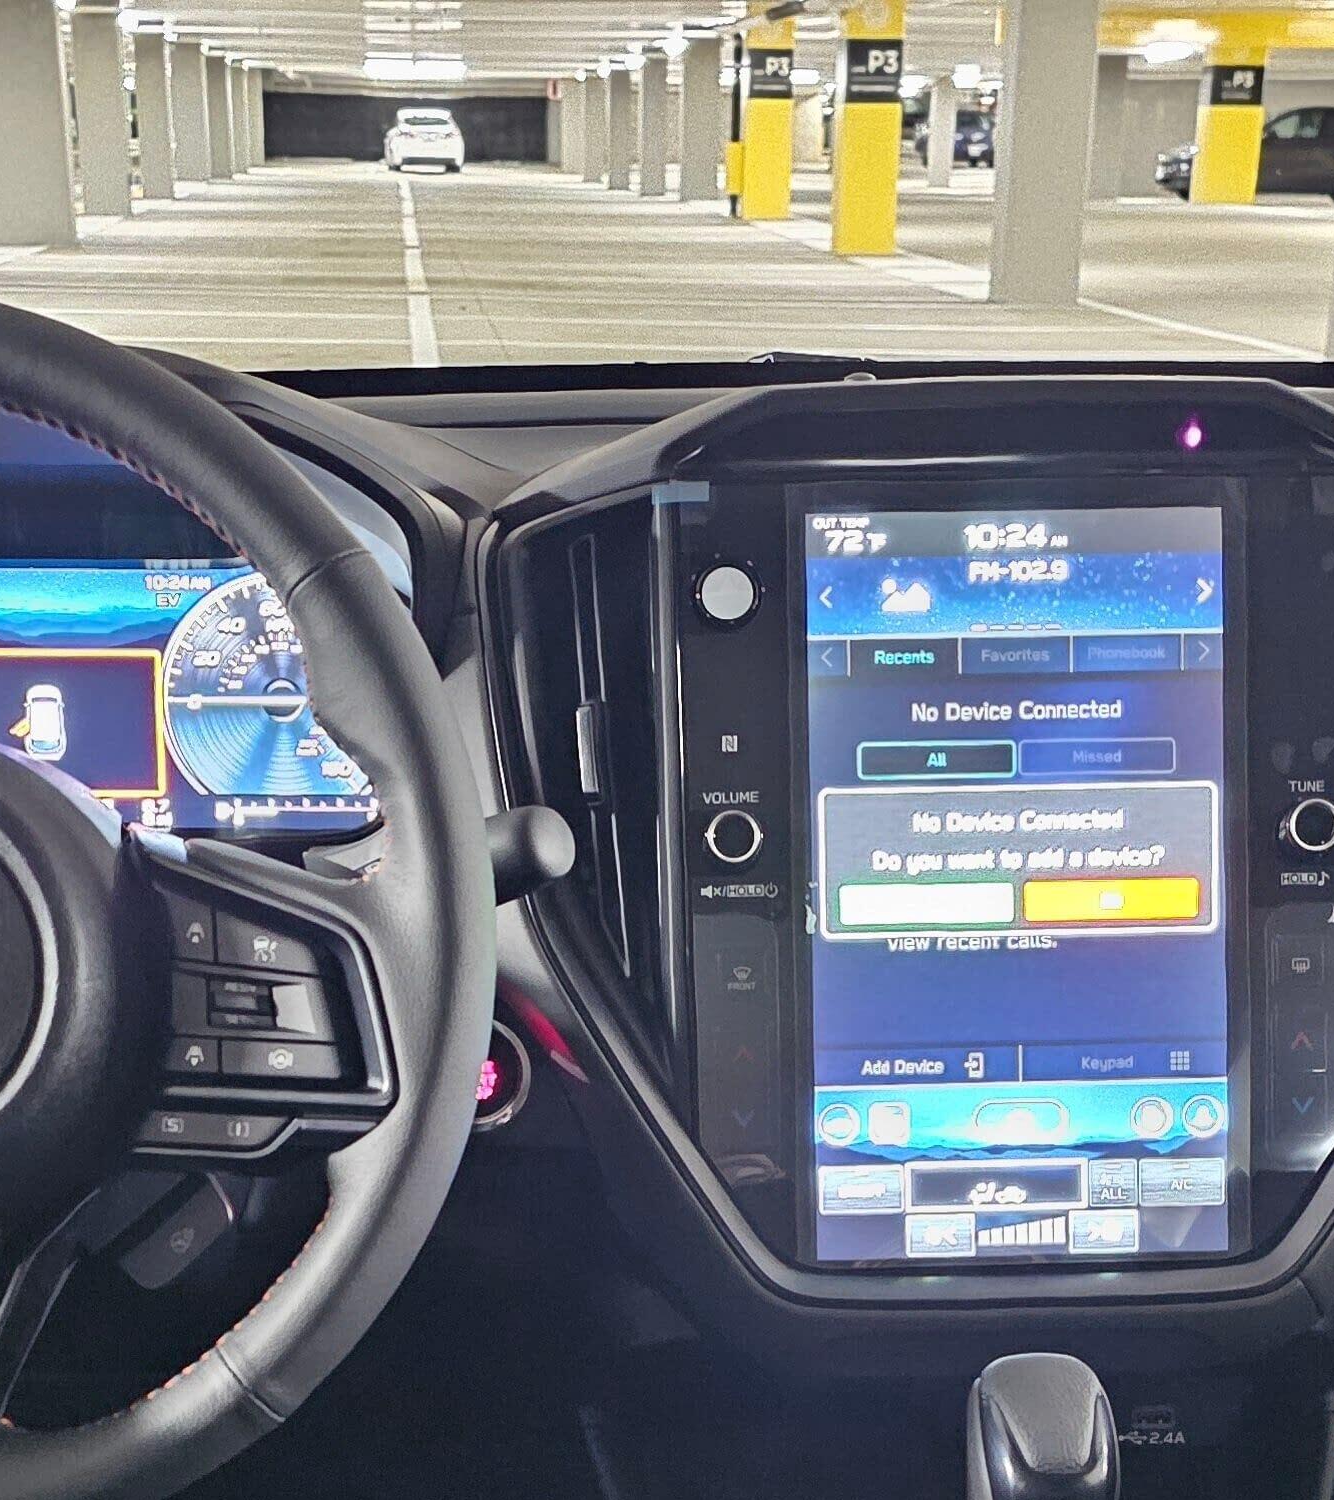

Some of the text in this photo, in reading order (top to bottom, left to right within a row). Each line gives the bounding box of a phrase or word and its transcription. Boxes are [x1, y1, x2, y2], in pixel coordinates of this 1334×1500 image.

[765, 56, 790, 77] P3
[868, 49, 899, 74] P3
[963, 523, 1047, 548] 10:24
[156, 593, 181, 608] EV
[217, 617, 246, 634] 40
[192, 650, 221, 667] 20
[874, 649, 935, 665] Recents
[981, 649, 1050, 662] Favorites
[1087, 646, 1166, 660] Phonebook
[911, 699, 1122, 722] No Device Connected
[926, 752, 947, 768] All
[1072, 750, 1122, 763] Missed
[1288, 780, 1325, 793] TUNE
[703, 791, 760, 804] VOLUME
[912, 809, 1124, 833] No Device Connected
[871, 844, 1165, 875] Do you want to add a device?
[1281, 873, 1317, 885] HOLD
[727, 884, 764, 897] HOLD
[886, 935, 1058, 951] view recent calls.
[727, 981, 756, 991] FRONT
[861, 1059, 945, 1075] Add Device
[1081, 1055, 1134, 1072] Keypad
[1170, 1179, 1192, 1191] A/C
[1101, 1187, 1127, 1200] ALL
[1149, 1430, 1185, 1445] 2.4A
